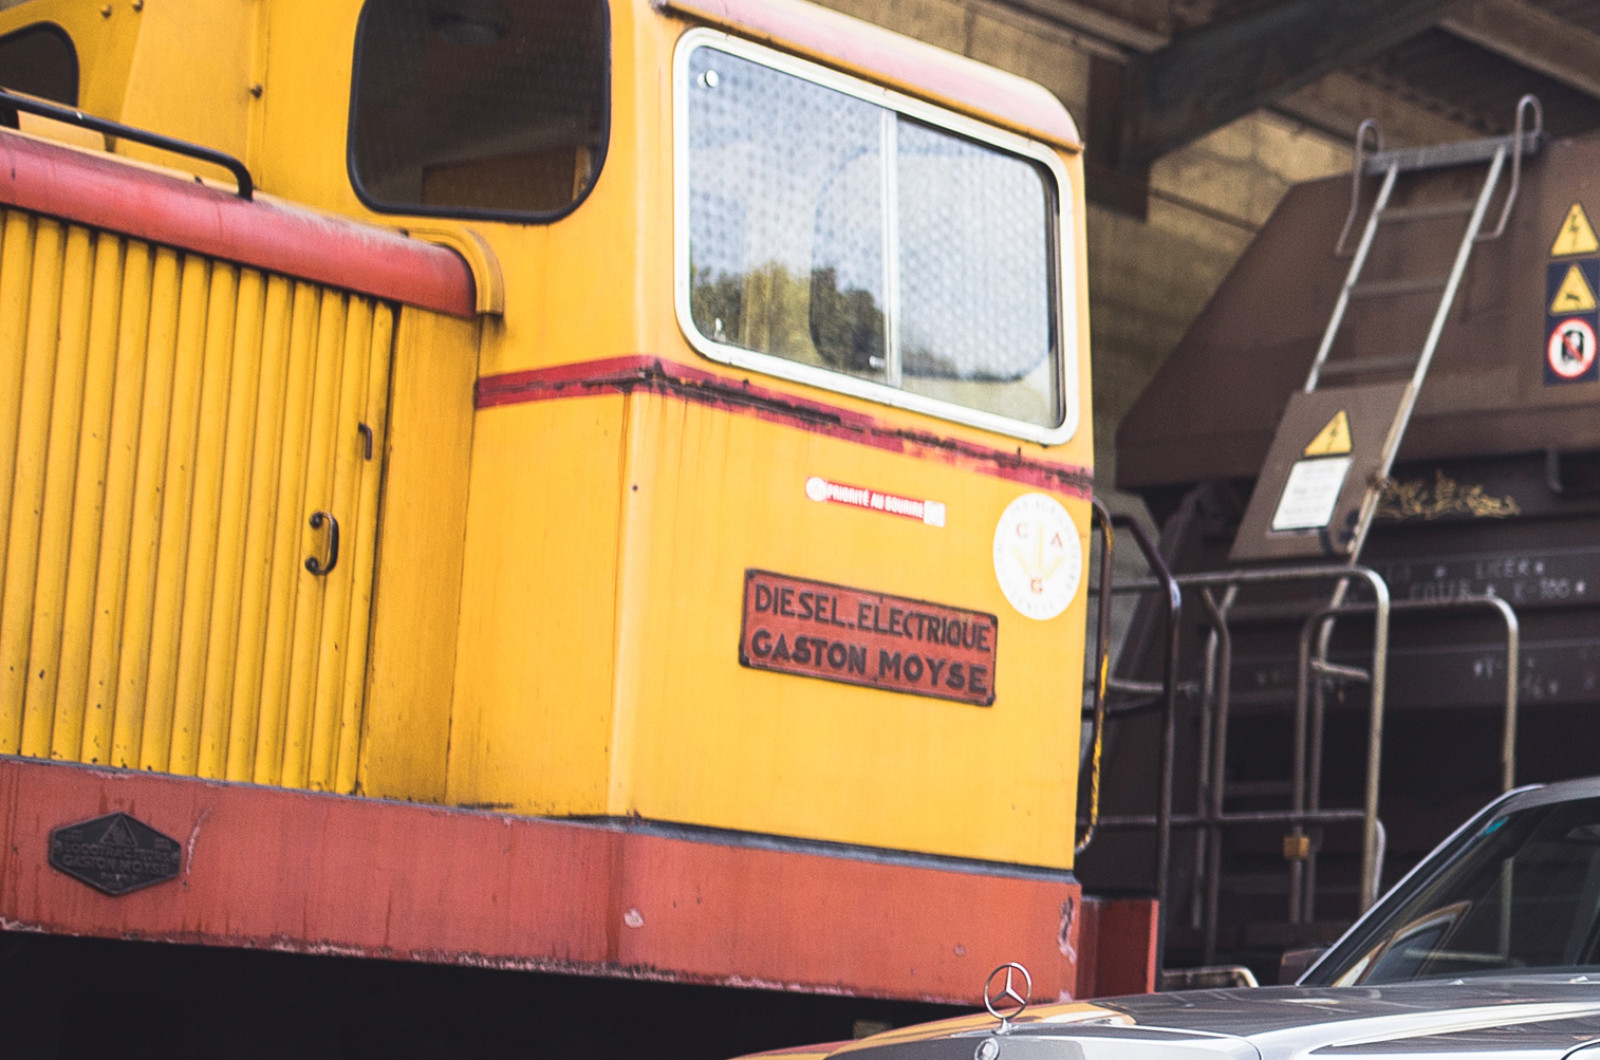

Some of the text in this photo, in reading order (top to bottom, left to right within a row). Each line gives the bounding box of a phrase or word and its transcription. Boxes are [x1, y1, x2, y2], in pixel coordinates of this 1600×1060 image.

[751, 627, 988, 694] GASTON MOYSE
[119, 858, 170, 876] MOYSE
